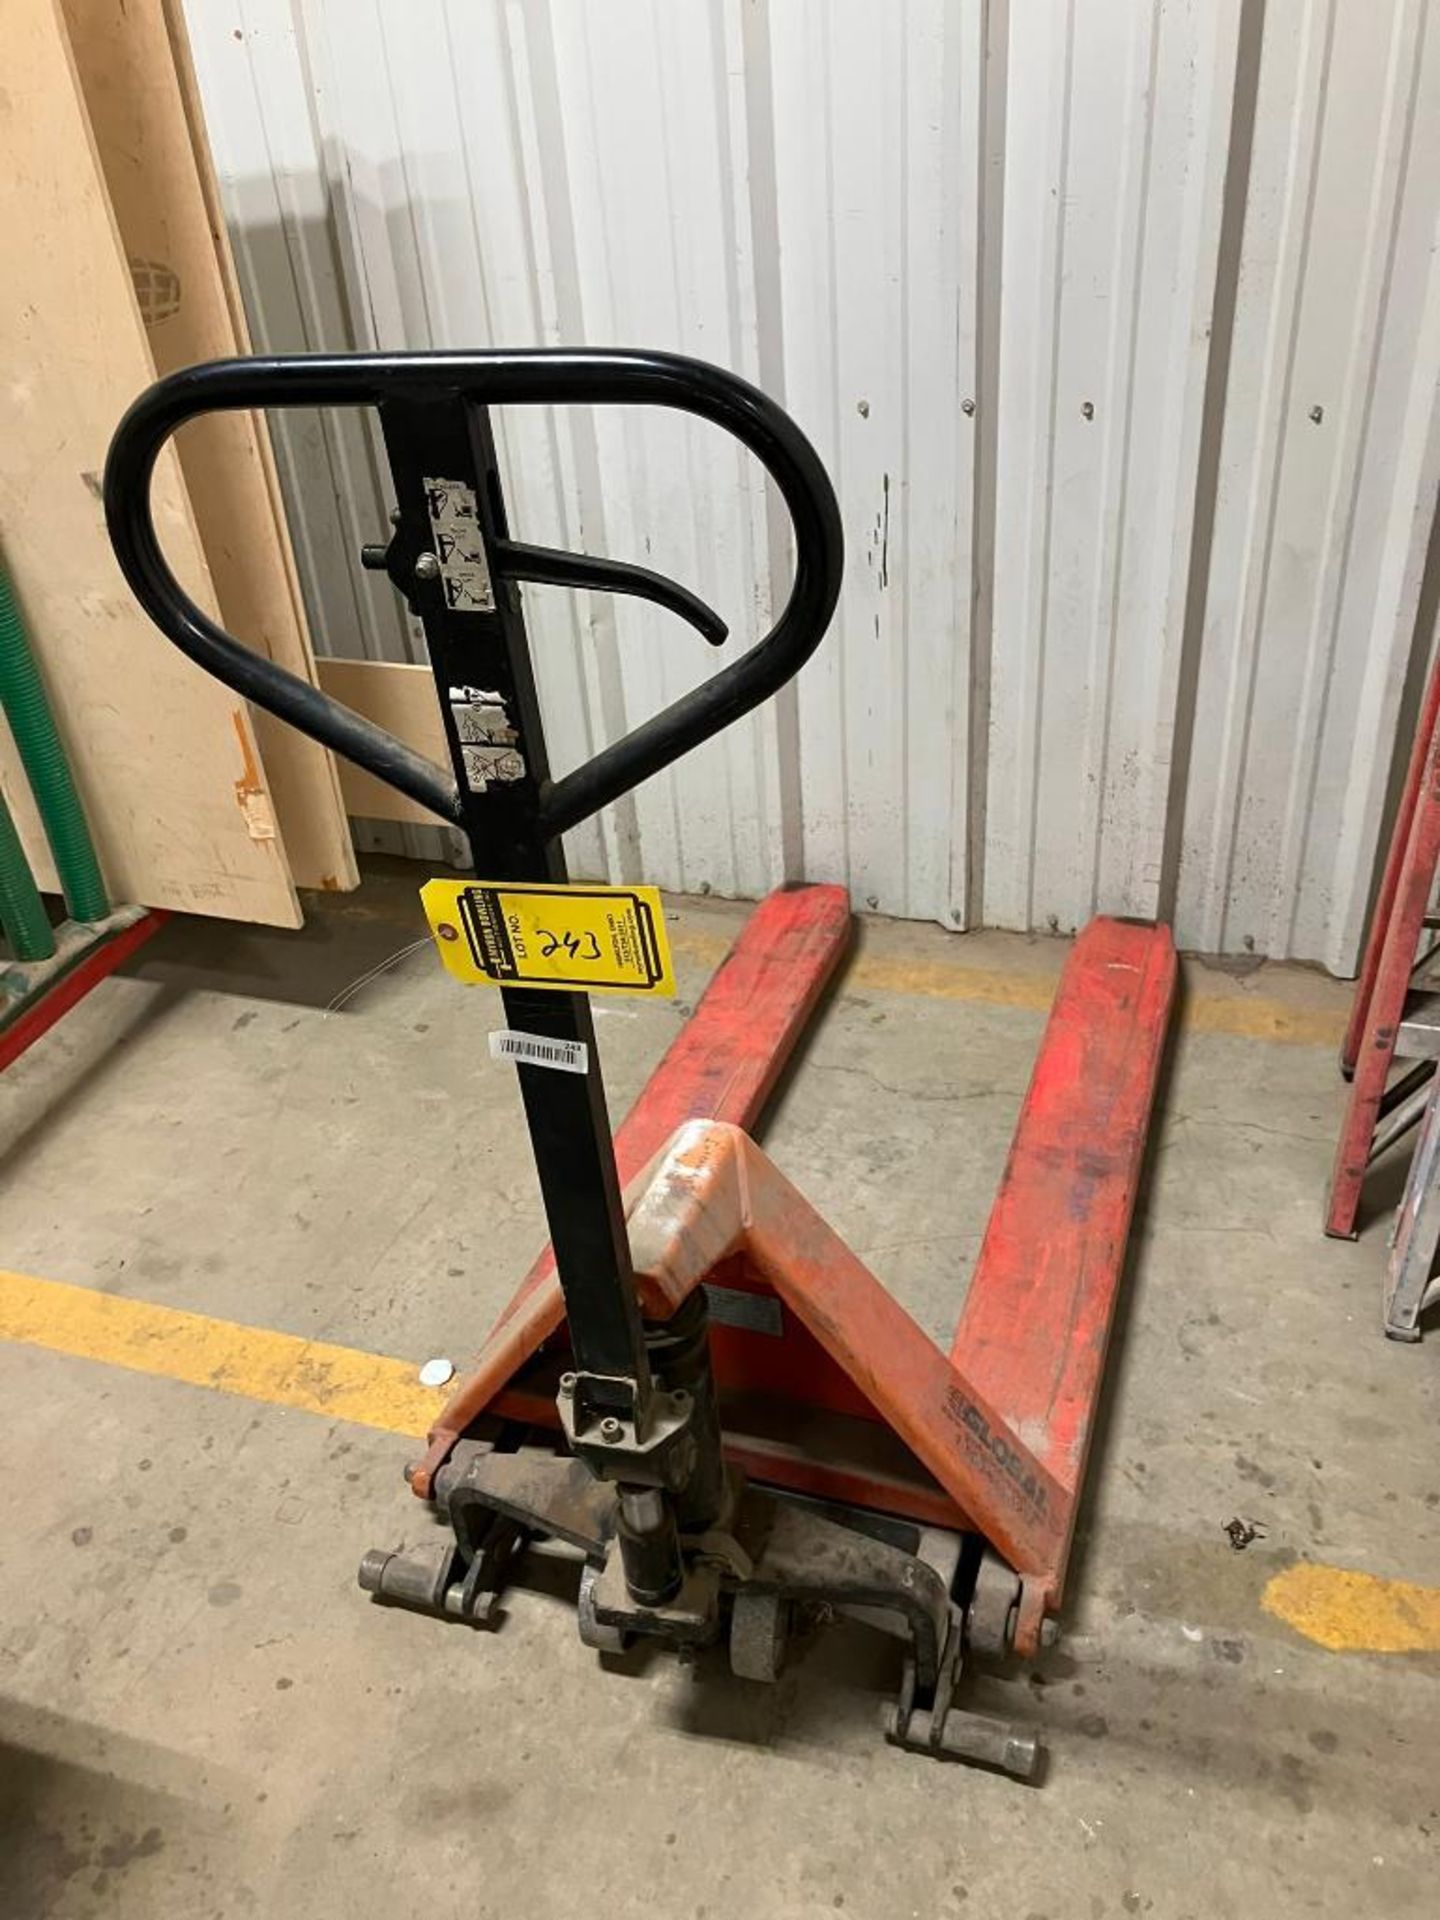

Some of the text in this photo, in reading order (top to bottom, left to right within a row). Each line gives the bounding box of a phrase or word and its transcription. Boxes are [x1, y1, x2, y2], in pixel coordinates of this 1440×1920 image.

[508, 913, 527, 958] LOT NO.
[536, 930, 602, 960] 243
